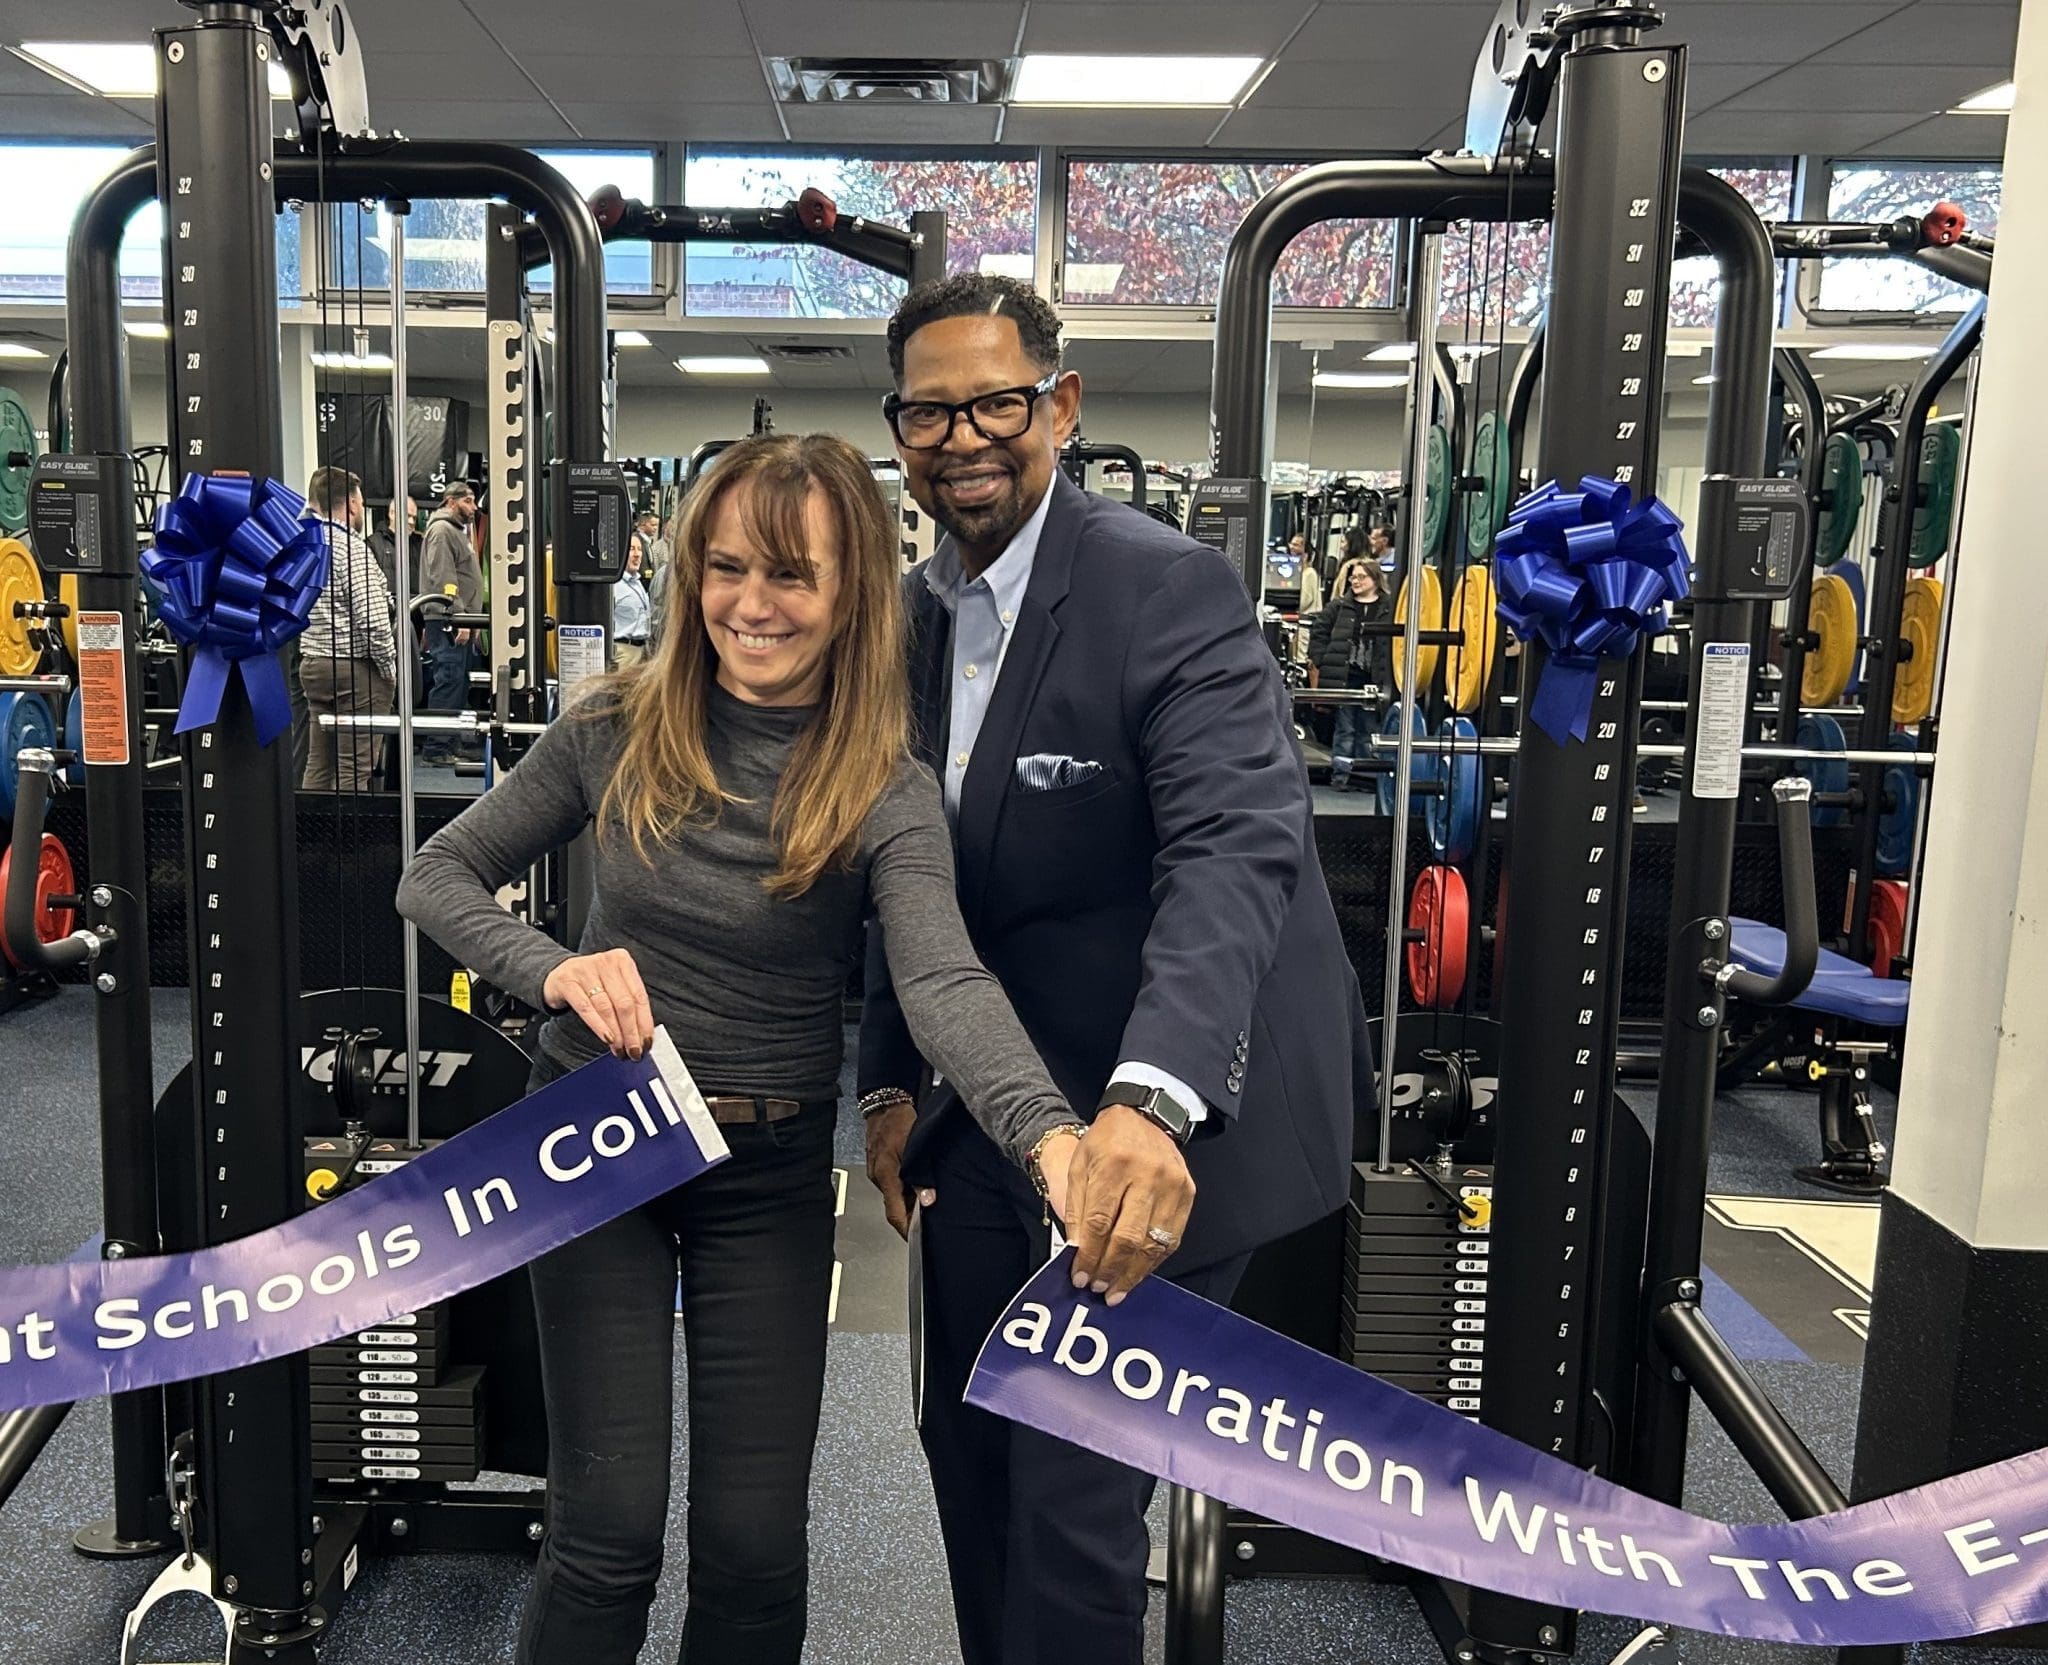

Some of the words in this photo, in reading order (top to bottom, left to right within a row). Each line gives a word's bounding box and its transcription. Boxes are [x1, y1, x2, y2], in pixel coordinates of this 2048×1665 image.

[177, 177, 193, 194] 32
[1629, 198, 1651, 217] 32
[178, 221, 192, 239] 31
[1626, 244, 1644, 262] 31
[180, 265, 196, 283] 30
[1623, 288, 1644, 307] 30
[182, 309, 199, 326] 29
[1621, 333, 1643, 351] 29
[186, 352, 201, 370] 28
[1620, 377, 1641, 396] 28
[187, 396, 201, 413] 27
[1616, 421, 1637, 439] 27
[189, 439, 203, 456] 26
[40, 461, 63, 470] EASY
[571, 468, 591, 476] EASY
[1613, 465, 1634, 484] 26
[1739, 484, 1763, 492] EASY
[564, 629, 596, 637] NOTICE
[1715, 647, 1746, 655] NOTICE
[1599, 680, 1615, 697] 21
[1597, 722, 1617, 739] 20
[201, 732, 212, 748] 19
[1594, 764, 1610, 780] 19
[203, 773, 214, 789] 18
[204, 813, 215, 829] 17
[1591, 805, 1607, 822] 18
[206, 853, 217, 869] 16
[1588, 847, 1604, 863] 17
[208, 893, 219, 909] 15
[1586, 887, 1602, 904] 16
[210, 933, 220, 949] 14
[1583, 928, 1599, 944] 15
[211, 972, 222, 988] 13
[1582, 969, 1596, 985] 14
[212, 1012, 223, 1027] 12
[1578, 1009, 1593, 1025] 13
[214, 1051, 223, 1066] 11
[1575, 1049, 1590, 1065] 12
[215, 1089, 227, 1105] 10
[1573, 1089, 1585, 1104] 11
[217, 1128, 225, 1143] 9
[1570, 1128, 1586, 1144] 10
[218, 1166, 226, 1181] 8
[362, 1163, 373, 1171] 20
[1567, 1167, 1579, 1183] 9
[1468, 1188, 1479, 1197] 20
[94, 1224, 421, 1350] Schools
[443, 1177, 519, 1237] In
[538, 1077, 681, 1184] Coll
[221, 1204, 228, 1219] 7
[1565, 1207, 1576, 1222] 8
[1465, 1243, 1477, 1251] 40
[1564, 1246, 1574, 1261] 7
[1464, 1262, 1475, 1270] 50
[1463, 1282, 1474, 1290] 60
[1560, 1284, 1571, 1299] 6
[1463, 1302, 1472, 1310] 70
[366, 1334, 380, 1342] 100
[1558, 1323, 1569, 1338] 5
[366, 1353, 379, 1361] 110
[1459, 1361, 1472, 1369] 100
[1556, 1361, 1566, 1376] 4
[367, 1373, 380, 1381] 120
[1457, 1380, 1470, 1389] 110
[227, 1392, 235, 1407] 2
[1456, 1399, 1470, 1408] 120
[1553, 1399, 1564, 1414] 3
[228, 1429, 234, 1443] 1
[1001, 1301, 1425, 1518] aboration
[1463, 1475, 1684, 1589] With
[1708, 1553, 1915, 1603] The
[1552, 1437, 1563, 1452] 2
